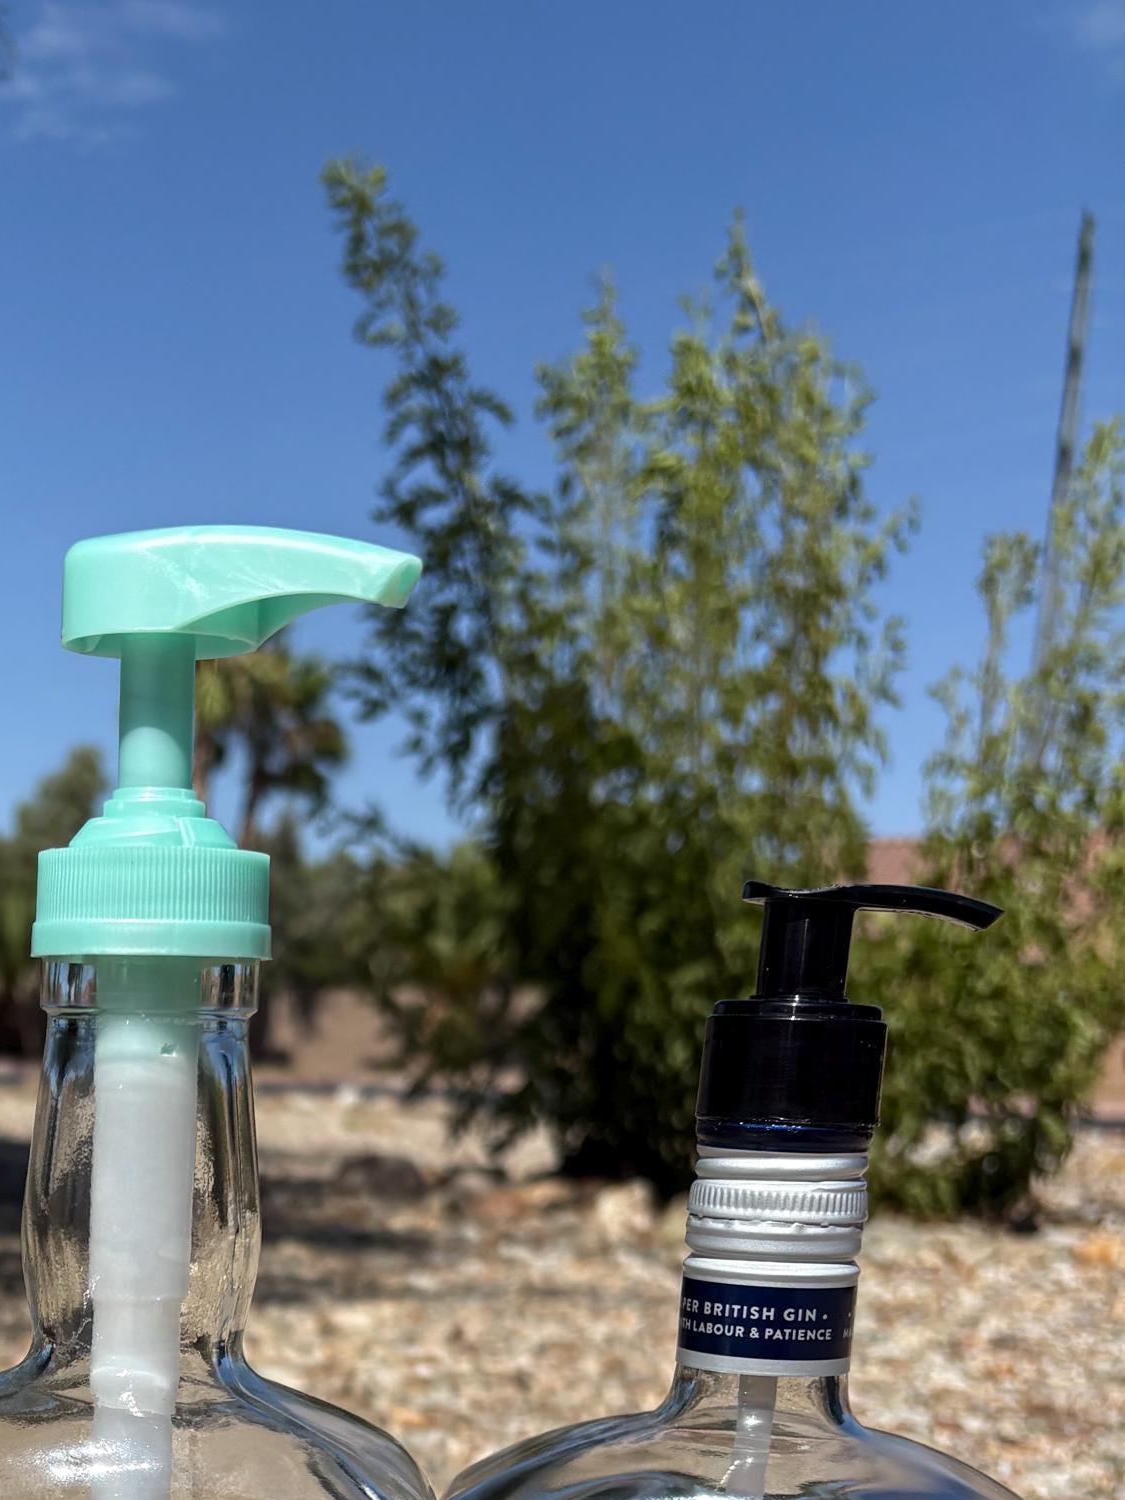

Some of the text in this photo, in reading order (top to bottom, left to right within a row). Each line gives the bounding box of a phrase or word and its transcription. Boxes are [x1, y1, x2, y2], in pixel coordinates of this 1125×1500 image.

[703, 1302, 775, 1321] BRITISH
[783, 1308, 817, 1321] GIN
[693, 1320, 744, 1337] LABOUR
[749, 1328, 760, 1339] &
[765, 1328, 832, 1341] PATIENCE
